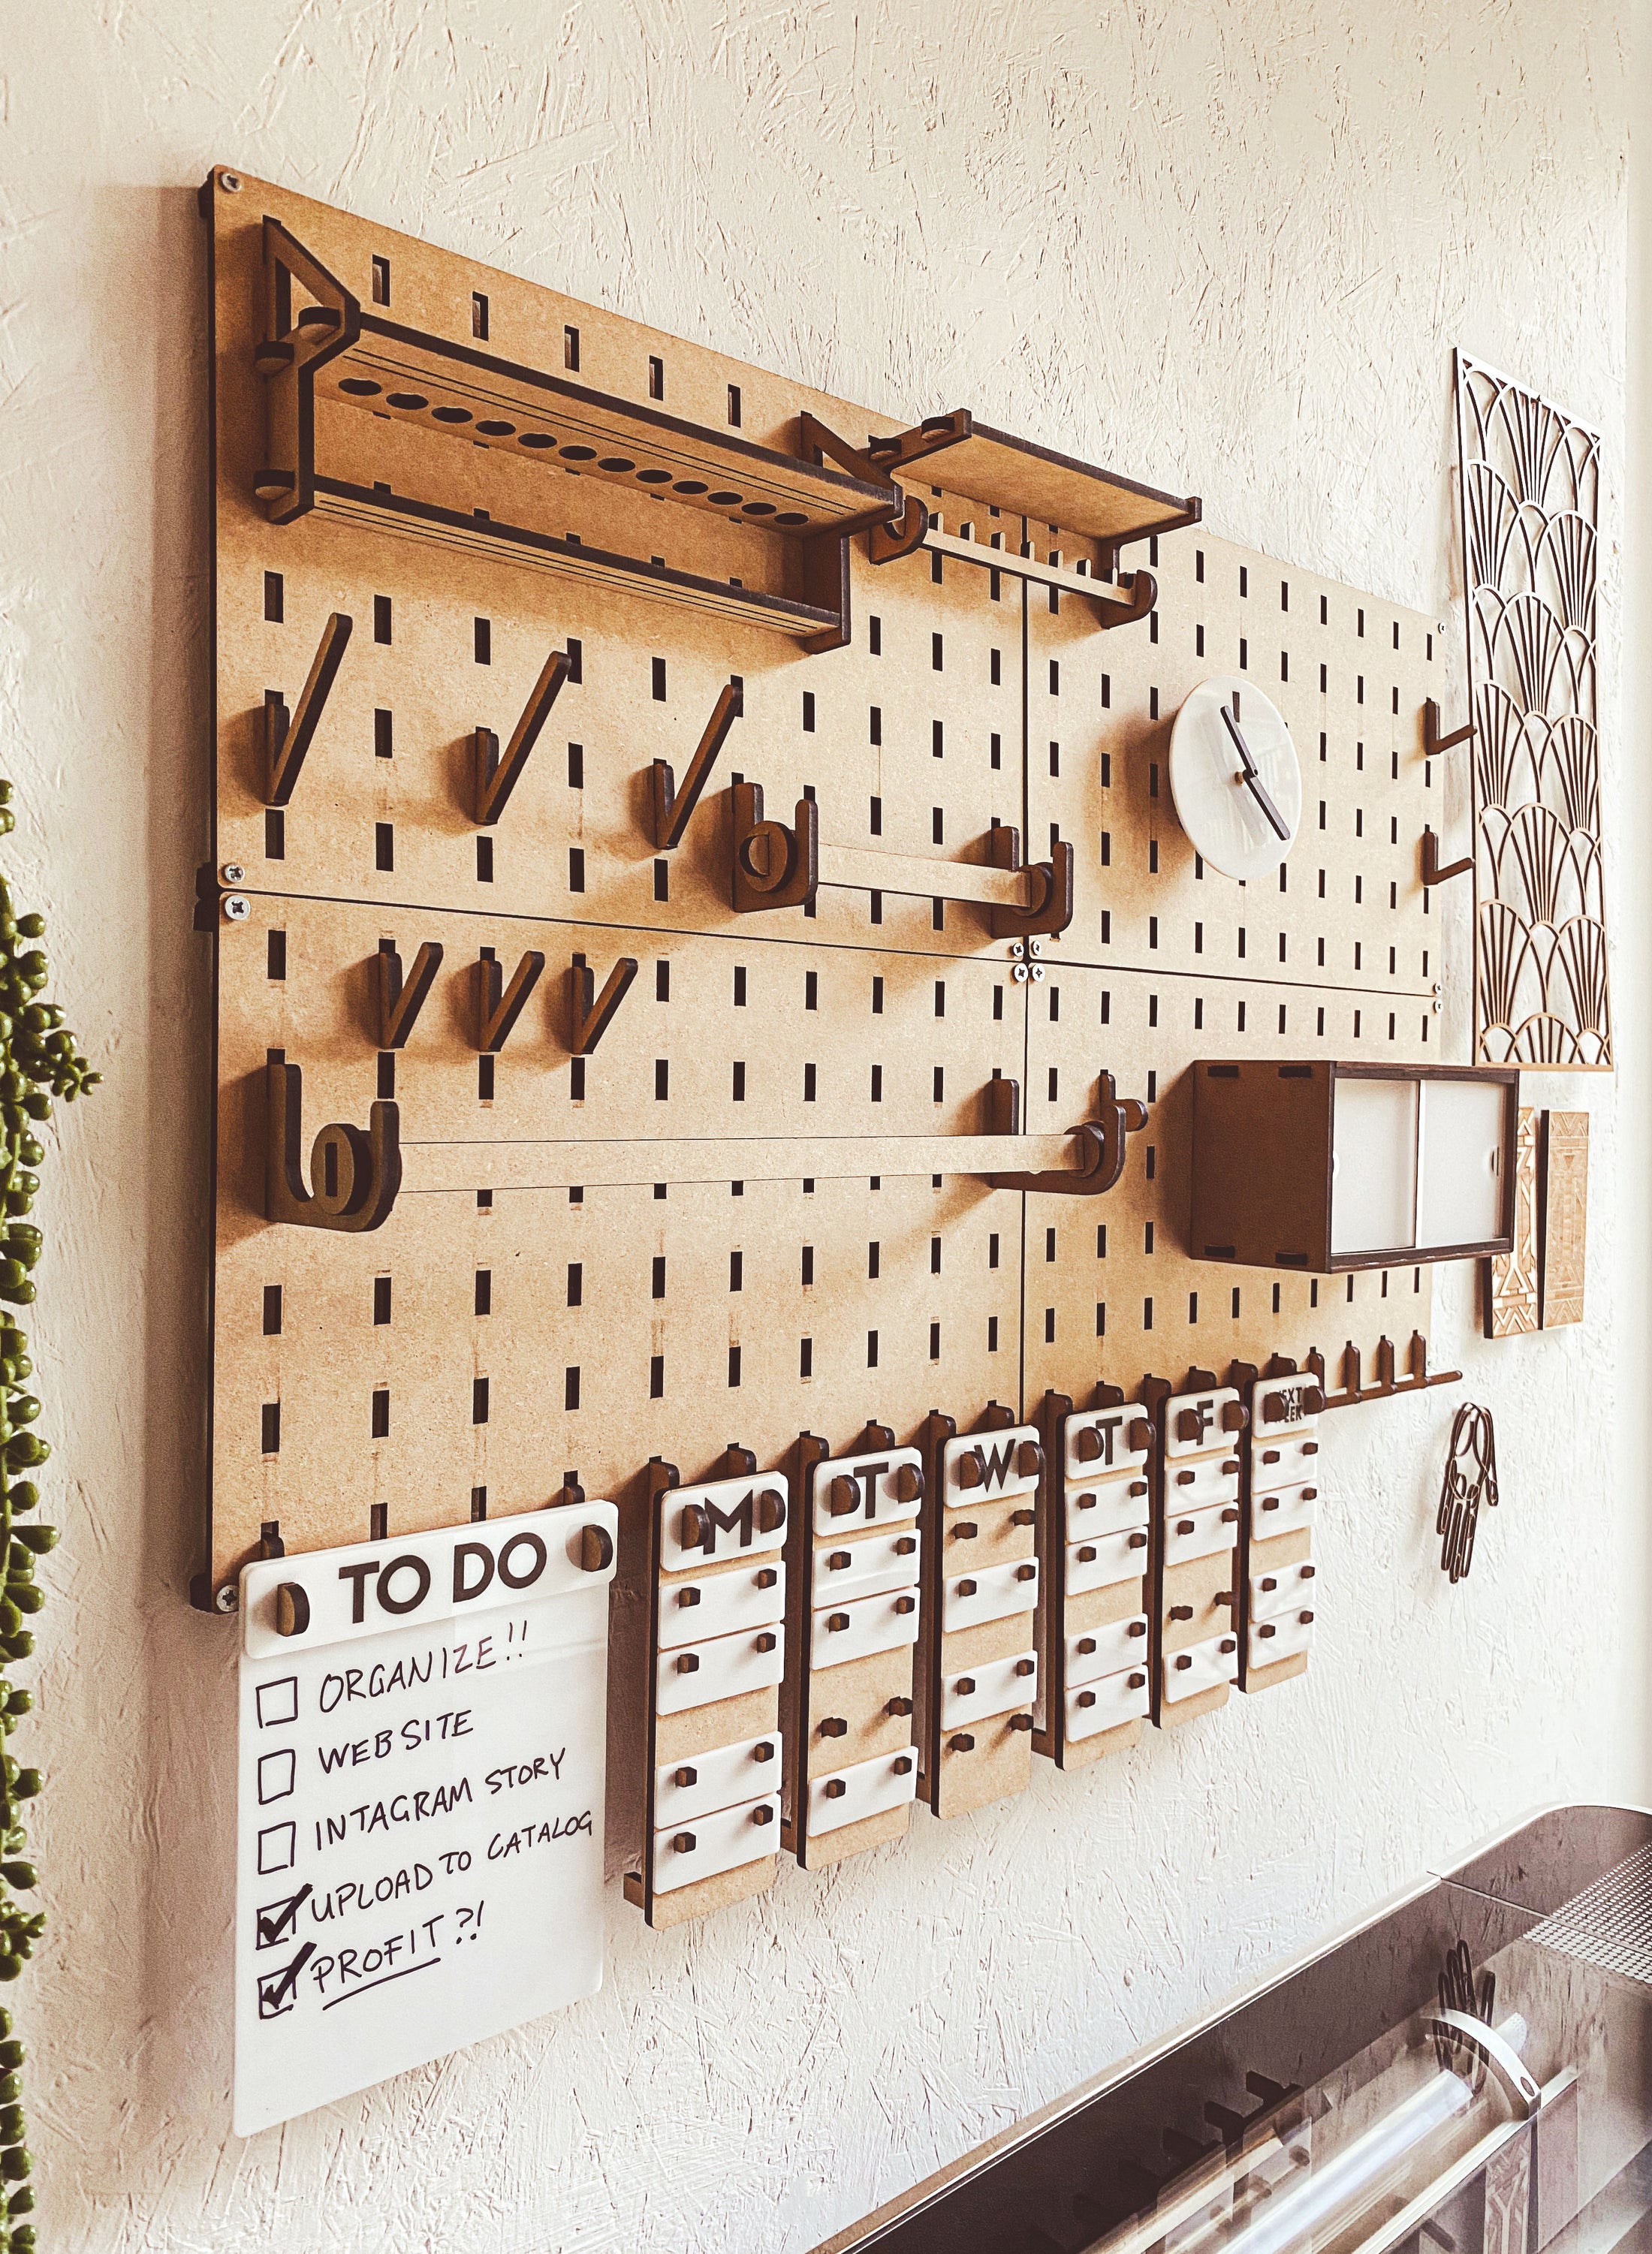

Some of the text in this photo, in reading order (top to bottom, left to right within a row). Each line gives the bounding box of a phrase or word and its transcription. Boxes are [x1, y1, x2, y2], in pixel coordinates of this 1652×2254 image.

[1196, 1399, 1214, 1446] F
[1279, 1386, 1303, 1404] EXT
[974, 1439, 1017, 1493] W
[1096, 1416, 1123, 1465] T
[854, 1462, 889, 1520] T
[703, 1489, 753, 1555] M
[339, 1532, 547, 1624] TO DO
[318, 1709, 474, 1774] WEBSITE
[315, 1746, 566, 1852] INTAGRAM STORY
[311, 1810, 592, 1923] UPLOAD TO CATALOG
